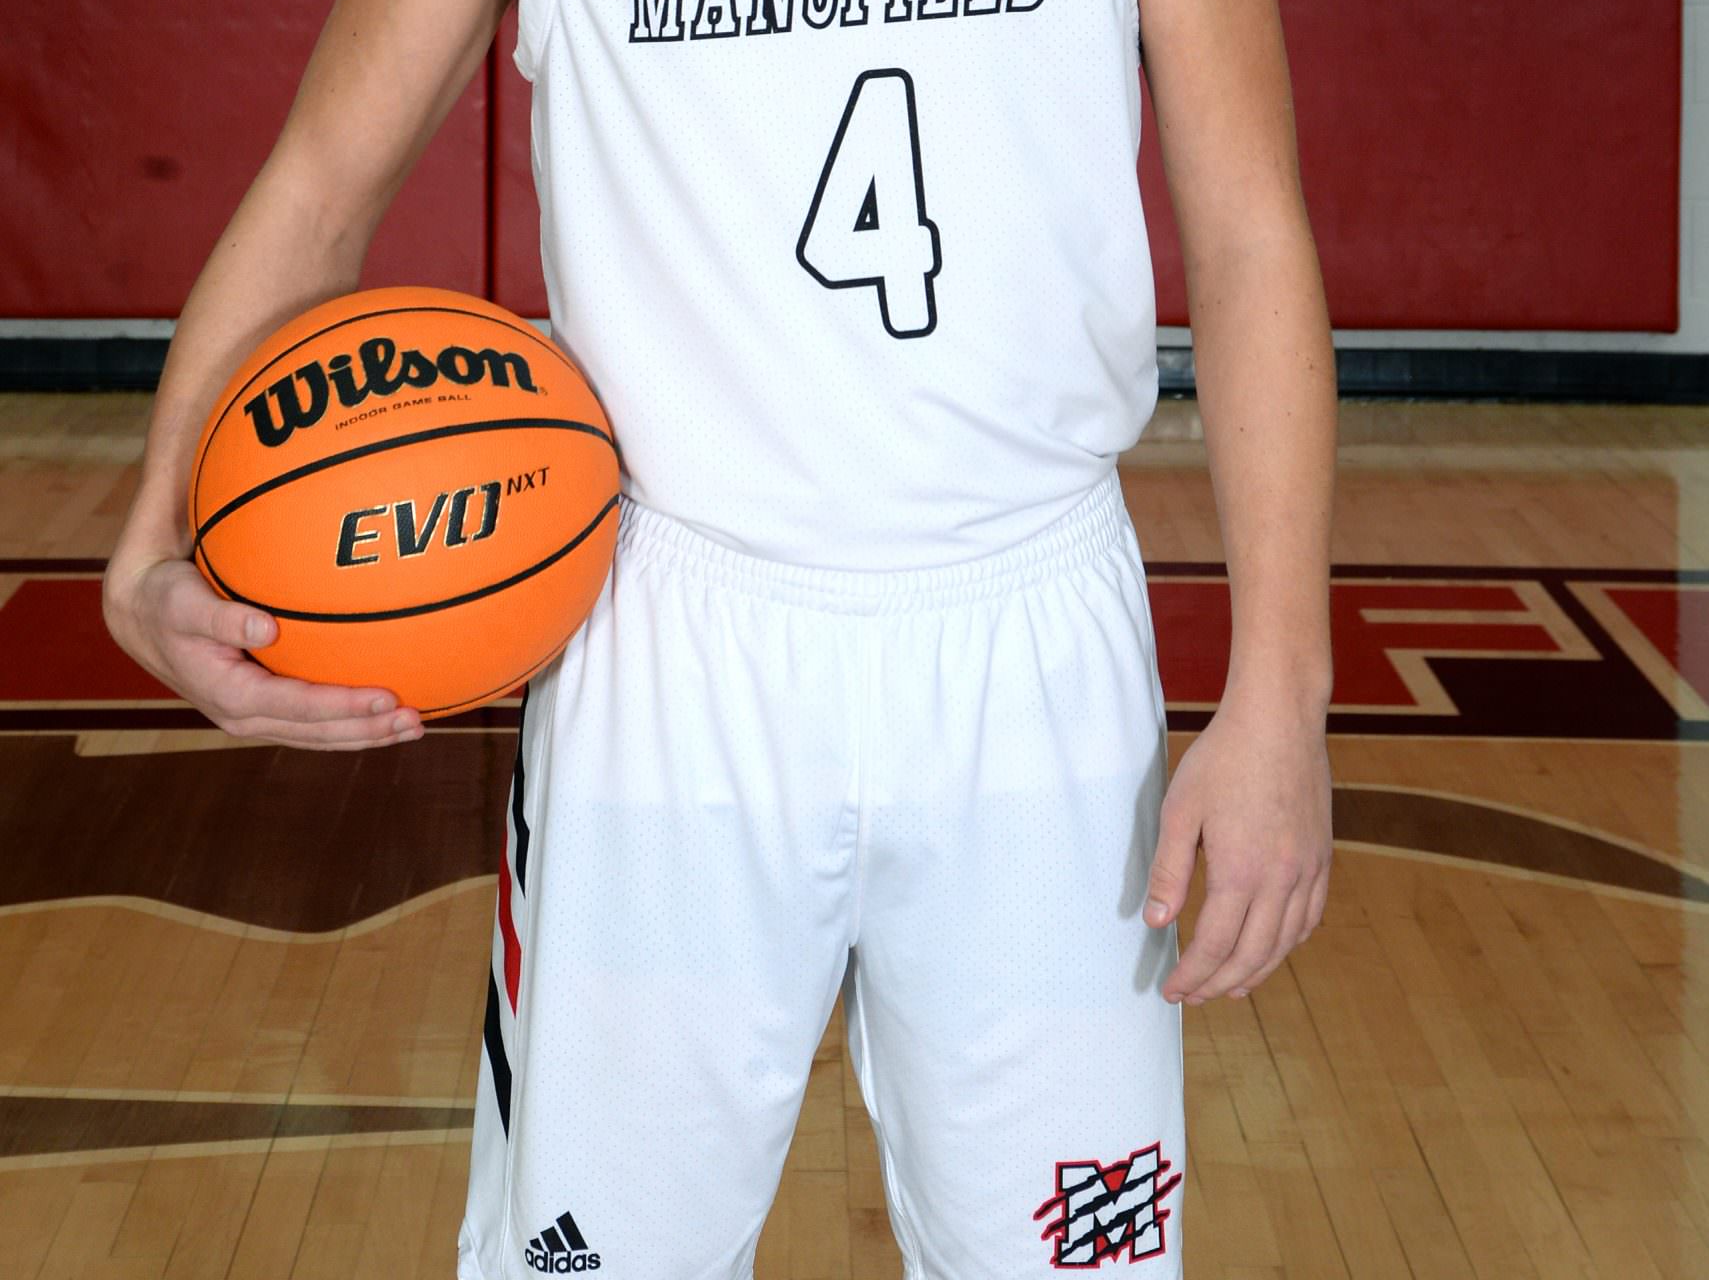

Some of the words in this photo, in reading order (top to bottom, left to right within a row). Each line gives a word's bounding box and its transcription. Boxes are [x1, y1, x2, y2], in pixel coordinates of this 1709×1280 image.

[795, 67, 943, 340] 4
[243, 337, 539, 449] Wilson
[335, 406, 388, 431] INDOOR
[392, 396, 433, 411] GAME
[437, 393, 473, 403] BALL
[334, 480, 502, 569] EVO
[506, 466, 551, 497] NXT
[525, 1248, 602, 1274] adidas
